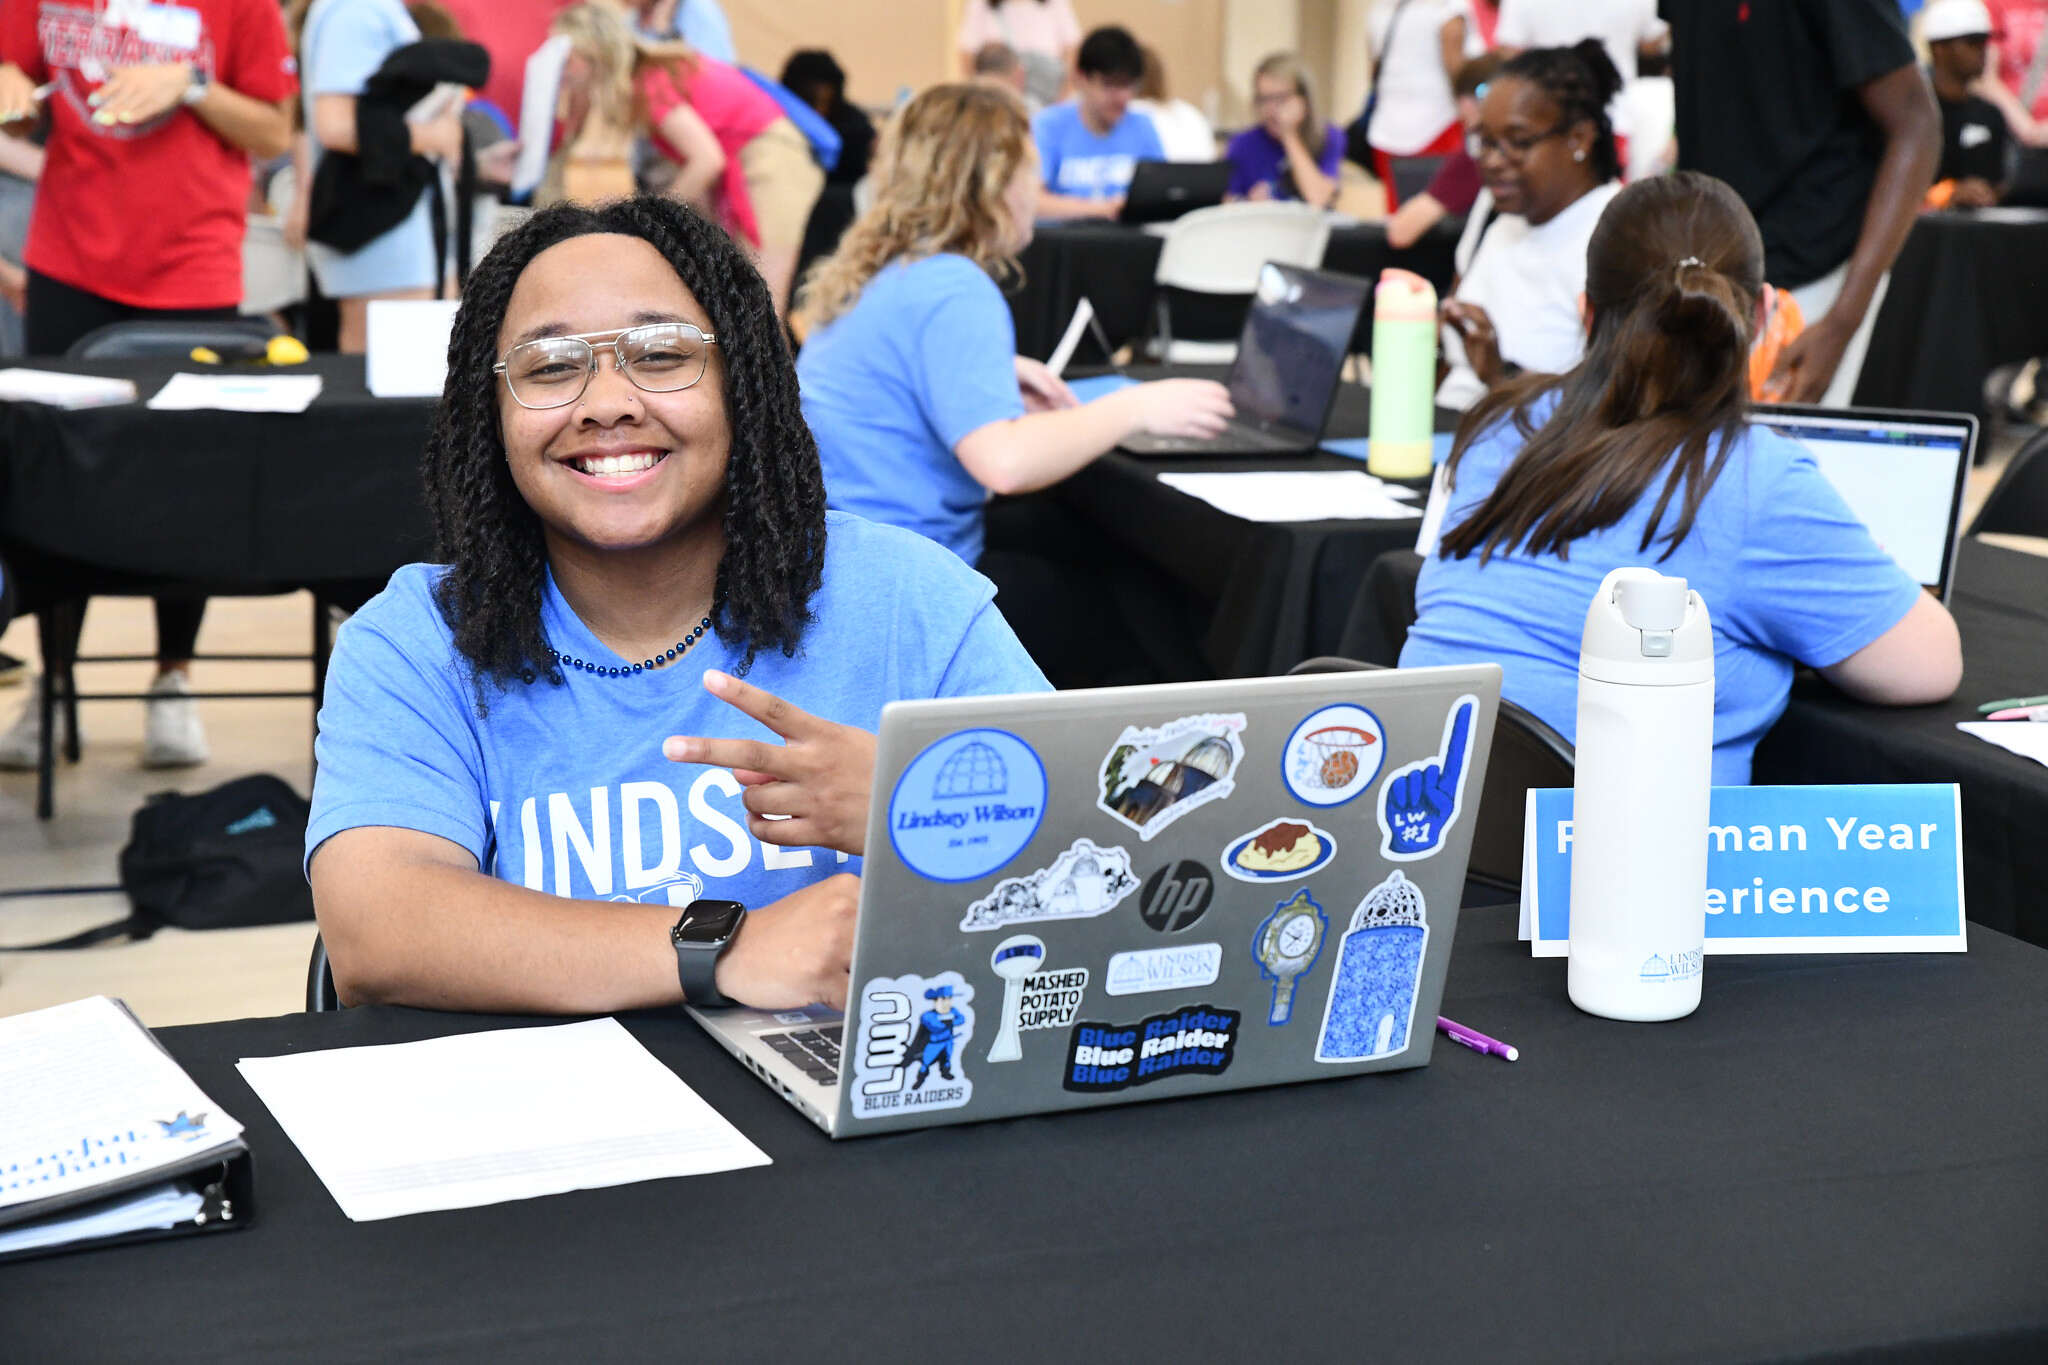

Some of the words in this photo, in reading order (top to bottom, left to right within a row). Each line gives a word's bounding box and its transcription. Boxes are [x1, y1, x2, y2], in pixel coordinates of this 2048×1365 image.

[898, 809, 969, 829] Lindsey
[974, 804, 1035, 822] Wilson
[490, 768, 849, 899] INDS
[1401, 822, 1431, 843] #1
[1558, 820, 1807, 854] Fman
[1825, 816, 1937, 851] Year
[1146, 861, 1210, 932] hp
[1705, 876, 1891, 915] erience
[1023, 972, 1085, 992] MASHED
[1147, 962, 1213, 979] WILSON
[1020, 990, 1079, 1010] POTATO
[1018, 1008, 1074, 1027] SUPPLY
[1079, 1028, 1136, 1048] Blue
[1144, 1011, 1232, 1040] Raider
[1075, 1045, 1134, 1066] Blue
[1140, 1028, 1229, 1059] Raider
[1072, 1064, 1130, 1084] Blue
[1137, 1048, 1225, 1077] Raider
[864, 1094, 900, 1110] BLUE
[904, 1087, 963, 1106] RAIDERS
